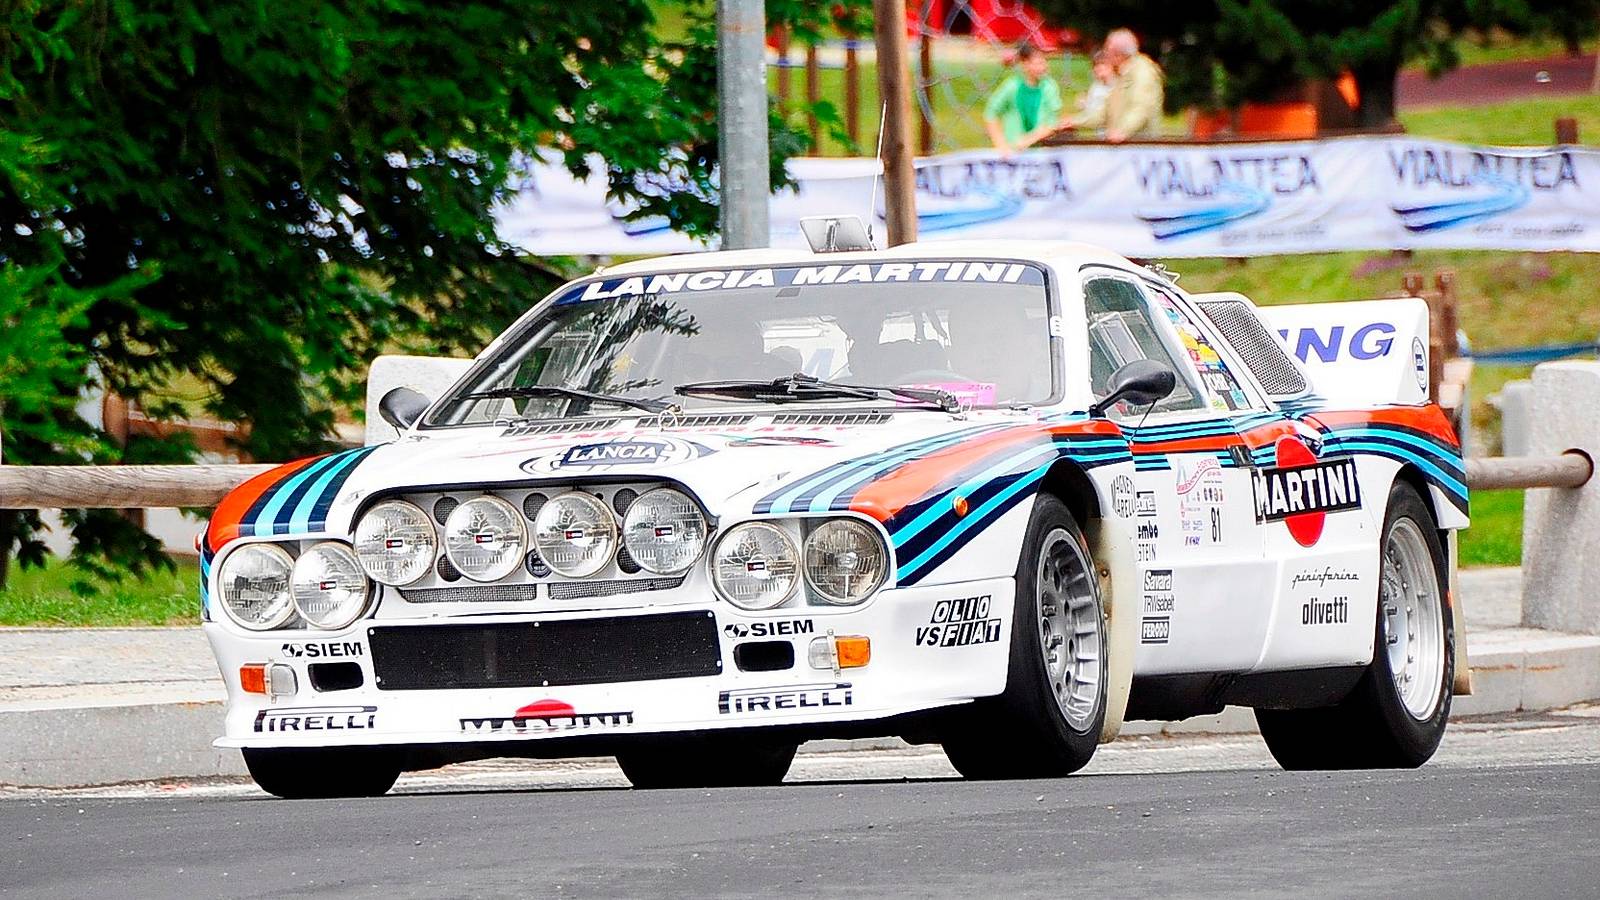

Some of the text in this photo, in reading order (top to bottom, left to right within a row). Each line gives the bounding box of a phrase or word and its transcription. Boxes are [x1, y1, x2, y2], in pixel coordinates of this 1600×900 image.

[1134, 154, 1321, 199] VIALATTEA
[1389, 148, 1580, 191] VIALATTEA
[581, 261, 1026, 301] LANCIA MARTINI
[568, 445, 658, 463] LANCIA
[1253, 463, 1357, 517] MARTINI
[1210, 506, 1222, 543] 81
[1292, 566, 1360, 589] pininfarina
[930, 595, 991, 623] OLIO
[1302, 596, 1348, 625] olivetti
[751, 619, 815, 637] SIEM
[305, 642, 363, 658] SIEM
[718, 682, 852, 714] PIRELLI
[253, 705, 378, 733] PIRELLI
